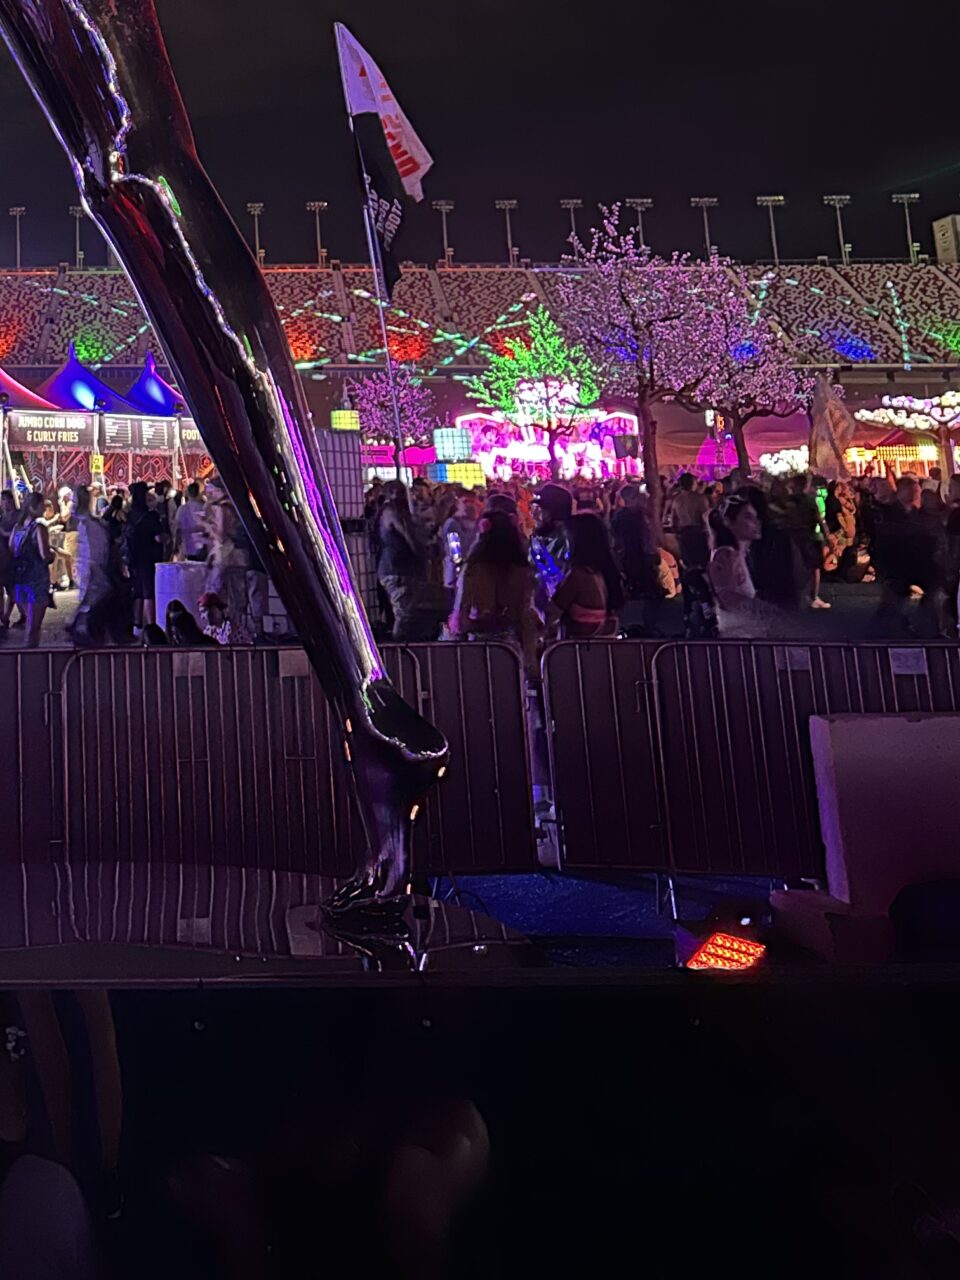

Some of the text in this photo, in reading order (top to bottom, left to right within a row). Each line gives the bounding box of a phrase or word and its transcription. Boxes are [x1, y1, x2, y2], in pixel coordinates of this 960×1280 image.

[18, 416, 43, 429] JUMBO
[44, 417, 65, 429] CORN
[26, 431, 79, 442] & CURLY FRIES
